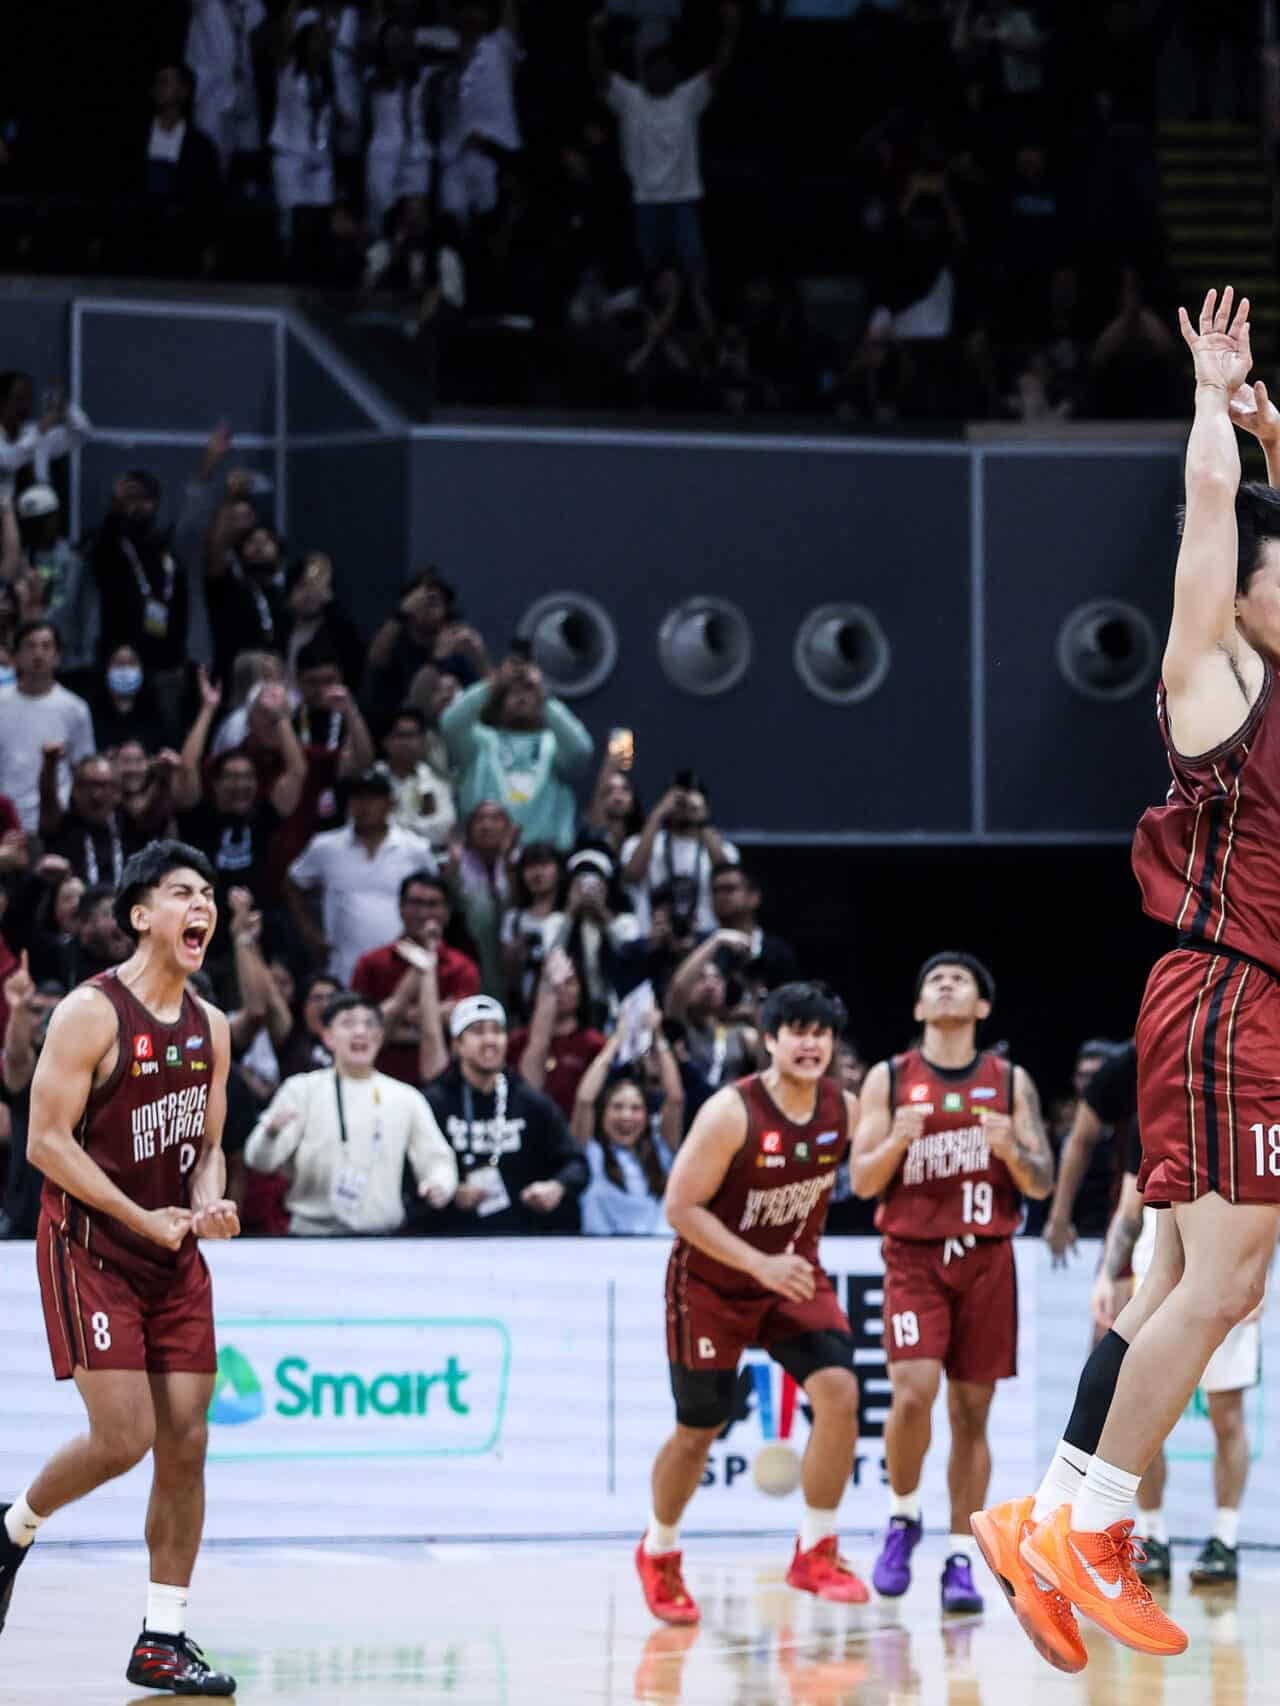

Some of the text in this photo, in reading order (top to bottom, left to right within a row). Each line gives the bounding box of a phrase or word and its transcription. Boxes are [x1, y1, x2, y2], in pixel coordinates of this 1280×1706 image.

[132, 1129, 156, 1164] NG
[961, 1180, 993, 1225] 19
[91, 1311, 111, 1351] 8
[892, 1310, 919, 1348] 19
[275, 1355, 470, 1418] Smart
